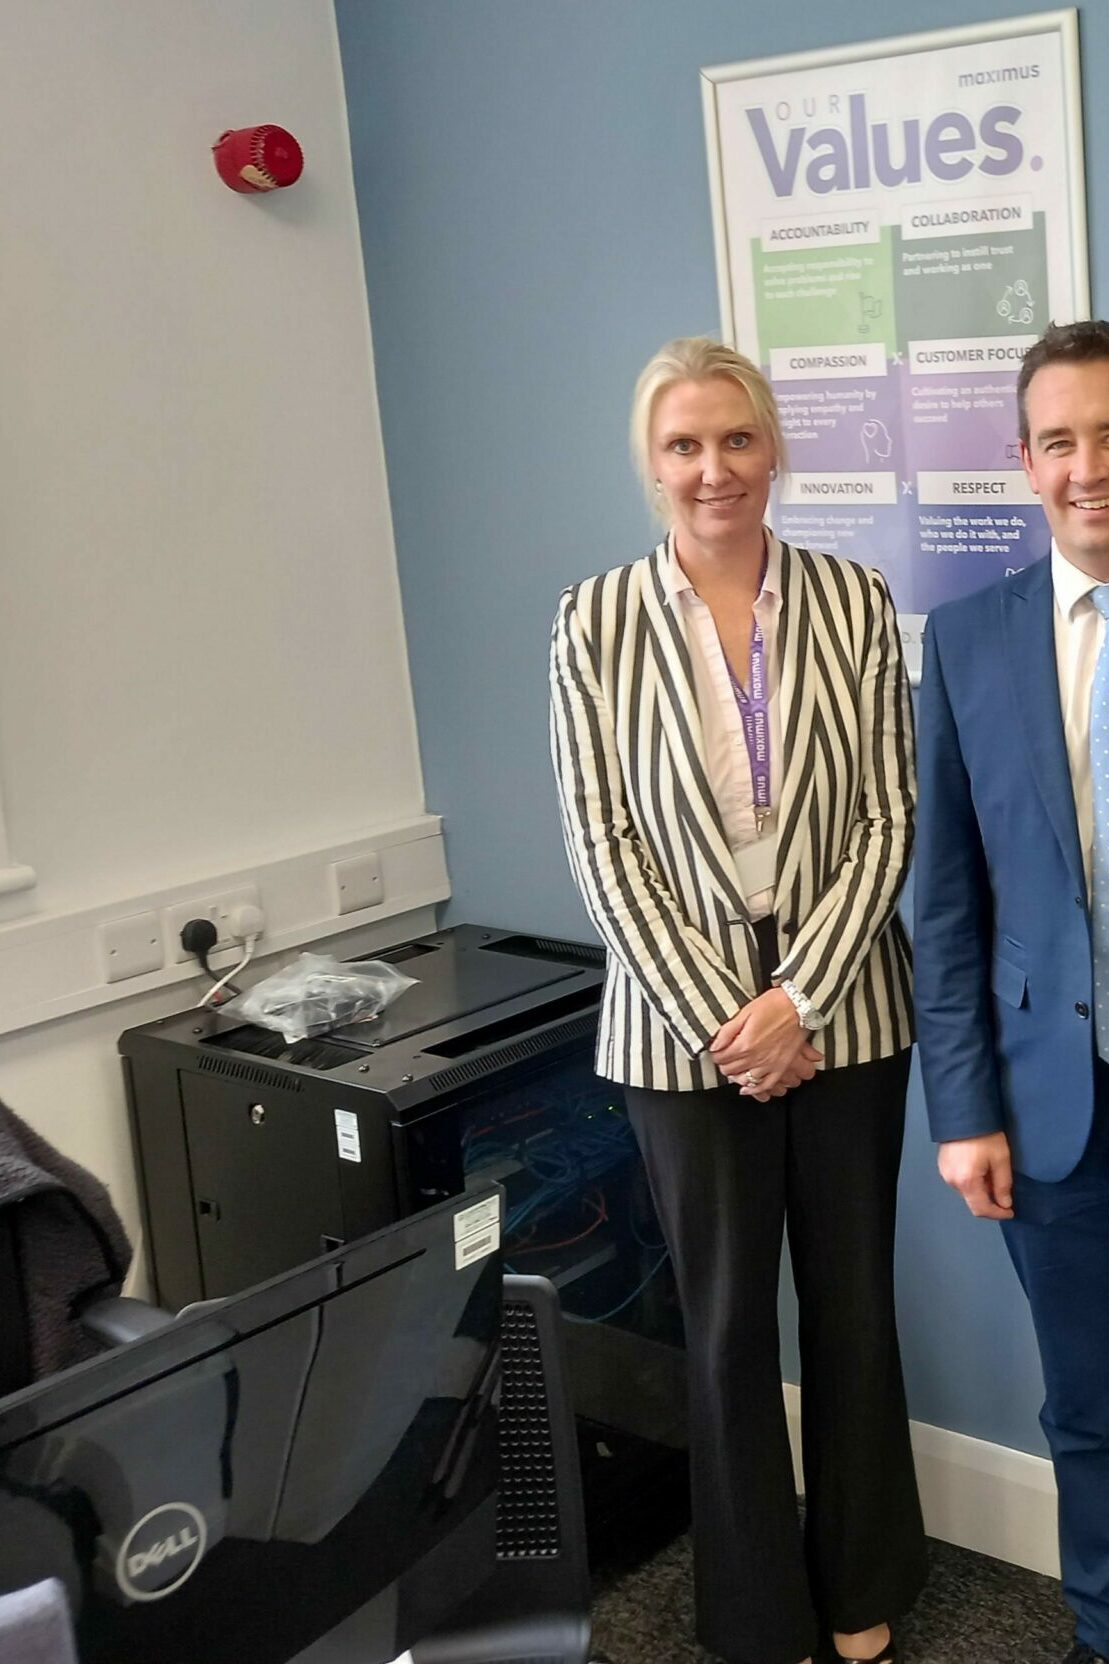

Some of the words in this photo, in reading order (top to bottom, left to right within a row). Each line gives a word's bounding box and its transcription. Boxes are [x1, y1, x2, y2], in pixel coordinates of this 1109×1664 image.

[958, 64, 1040, 88] maximus
[776, 94, 842, 122] OUR
[745, 93, 1043, 198] Values.
[911, 206, 1022, 228] COLLABORATION
[769, 220, 871, 241] ACCOUNTABILITY
[903, 265, 921, 276] and
[922, 263, 960, 275] working
[973, 261, 993, 270] one
[789, 355, 868, 369] COMPASSION
[916, 349, 985, 364] CUSTOMER
[800, 482, 874, 495] INNOVATION
[952, 481, 1007, 494] RESPECT
[918, 515, 952, 528] Valuing
[953, 515, 968, 526] the
[969, 515, 994, 526] work
[995, 518, 1009, 527] we
[919, 529, 939, 540] who
[940, 531, 954, 540] we
[955, 529, 968, 540] do
[969, 528, 977, 540] it
[1001, 528, 1020, 540] and
[919, 542, 936, 552] the
[936, 542, 970, 555] people
[970, 544, 984, 553] we
[984, 544, 1010, 554] serve
[751, 651, 763, 700] maximus
[754, 711, 765, 762] maximus
[127, 1526, 199, 1577] DELL
